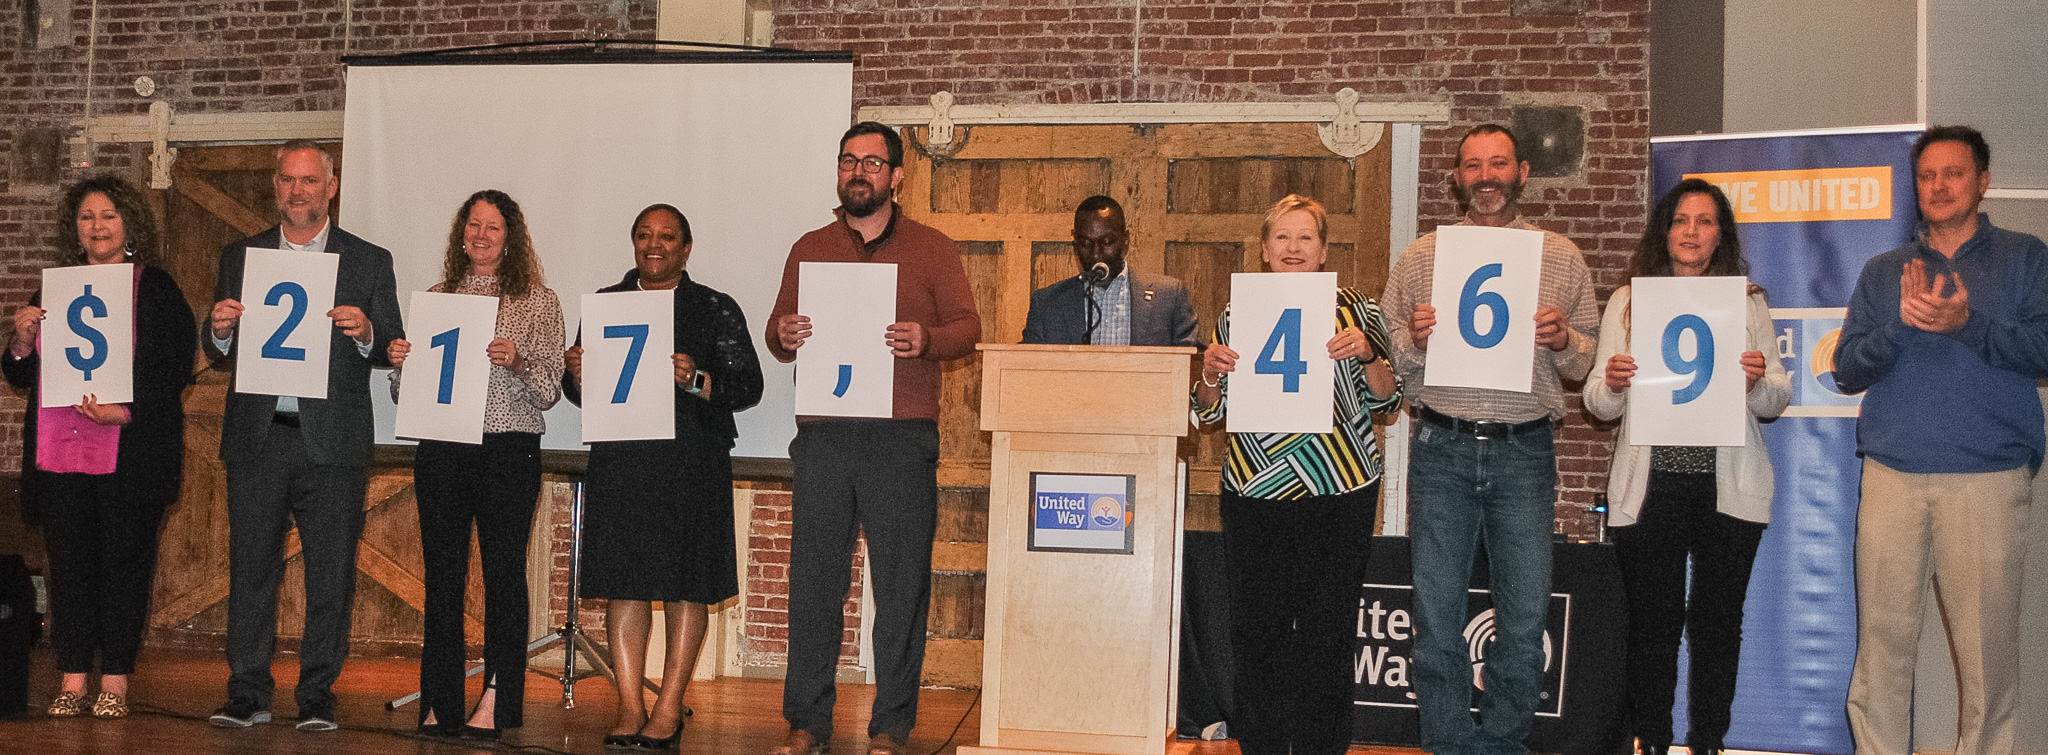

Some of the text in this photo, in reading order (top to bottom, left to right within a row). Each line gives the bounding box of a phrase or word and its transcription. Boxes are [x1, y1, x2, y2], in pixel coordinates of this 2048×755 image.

[1719, 177, 1880, 214] VE UNITED
[65, 285, 108, 381] $
[261, 282, 308, 361] 2
[1458, 263, 1510, 349] 6
[430, 327, 460, 405] 1
[603, 324, 650, 404] 7
[1255, 308, 1308, 393] 4
[1661, 314, 1715, 405] 9
[1038, 495, 1086, 511] United
[1056, 510, 1086, 529] Way
[1356, 597, 1417, 641] ite
[1354, 645, 1417, 699] Wa
